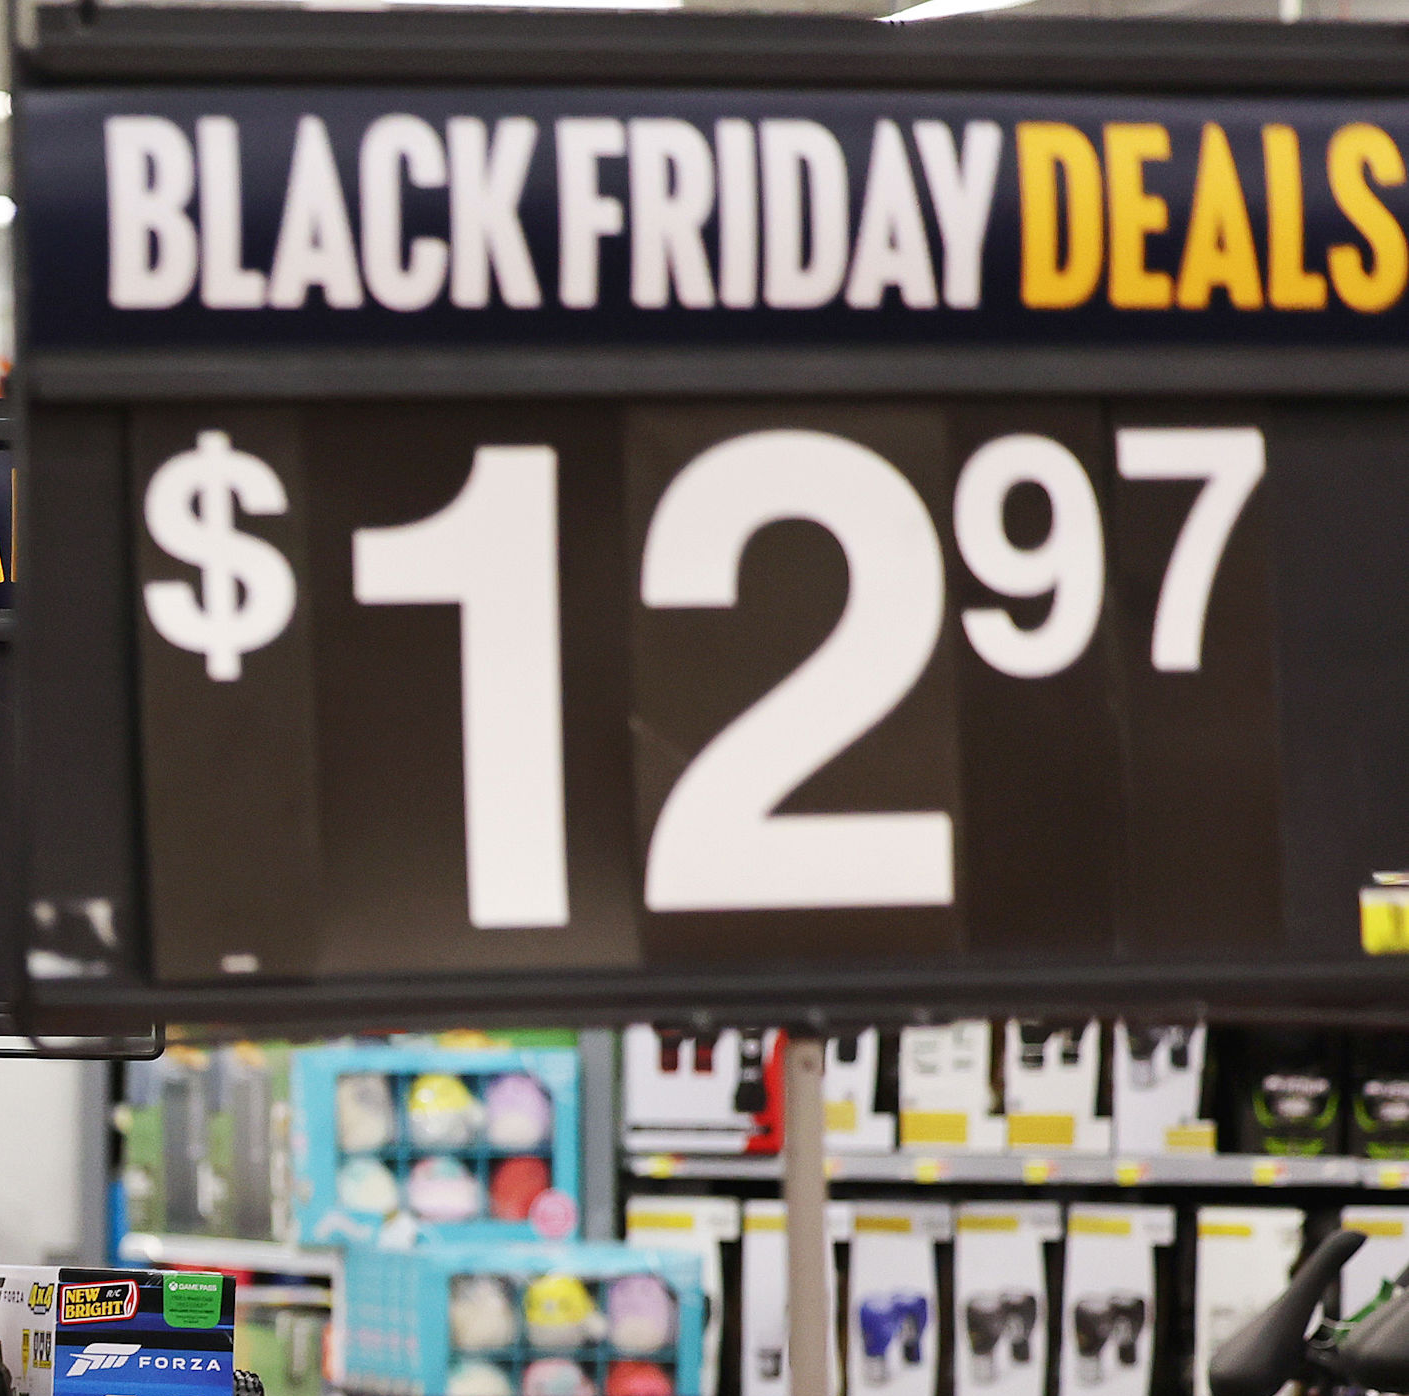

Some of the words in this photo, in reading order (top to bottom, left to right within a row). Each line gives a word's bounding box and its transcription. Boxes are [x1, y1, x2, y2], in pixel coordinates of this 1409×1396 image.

[104, 114, 542, 311] BLACK
[554, 116, 1003, 309] FRIDAY
[1015, 120, 1409, 314] DEALS
[65, 1287, 101, 1303] NEW
[106, 1288, 122, 1298] R/C
[179, 1282, 199, 1291] GAME
[199, 1283, 218, 1291] PASS
[65, 1300, 124, 1319] BRIGHT
[138, 1355, 221, 1372] FORZA
